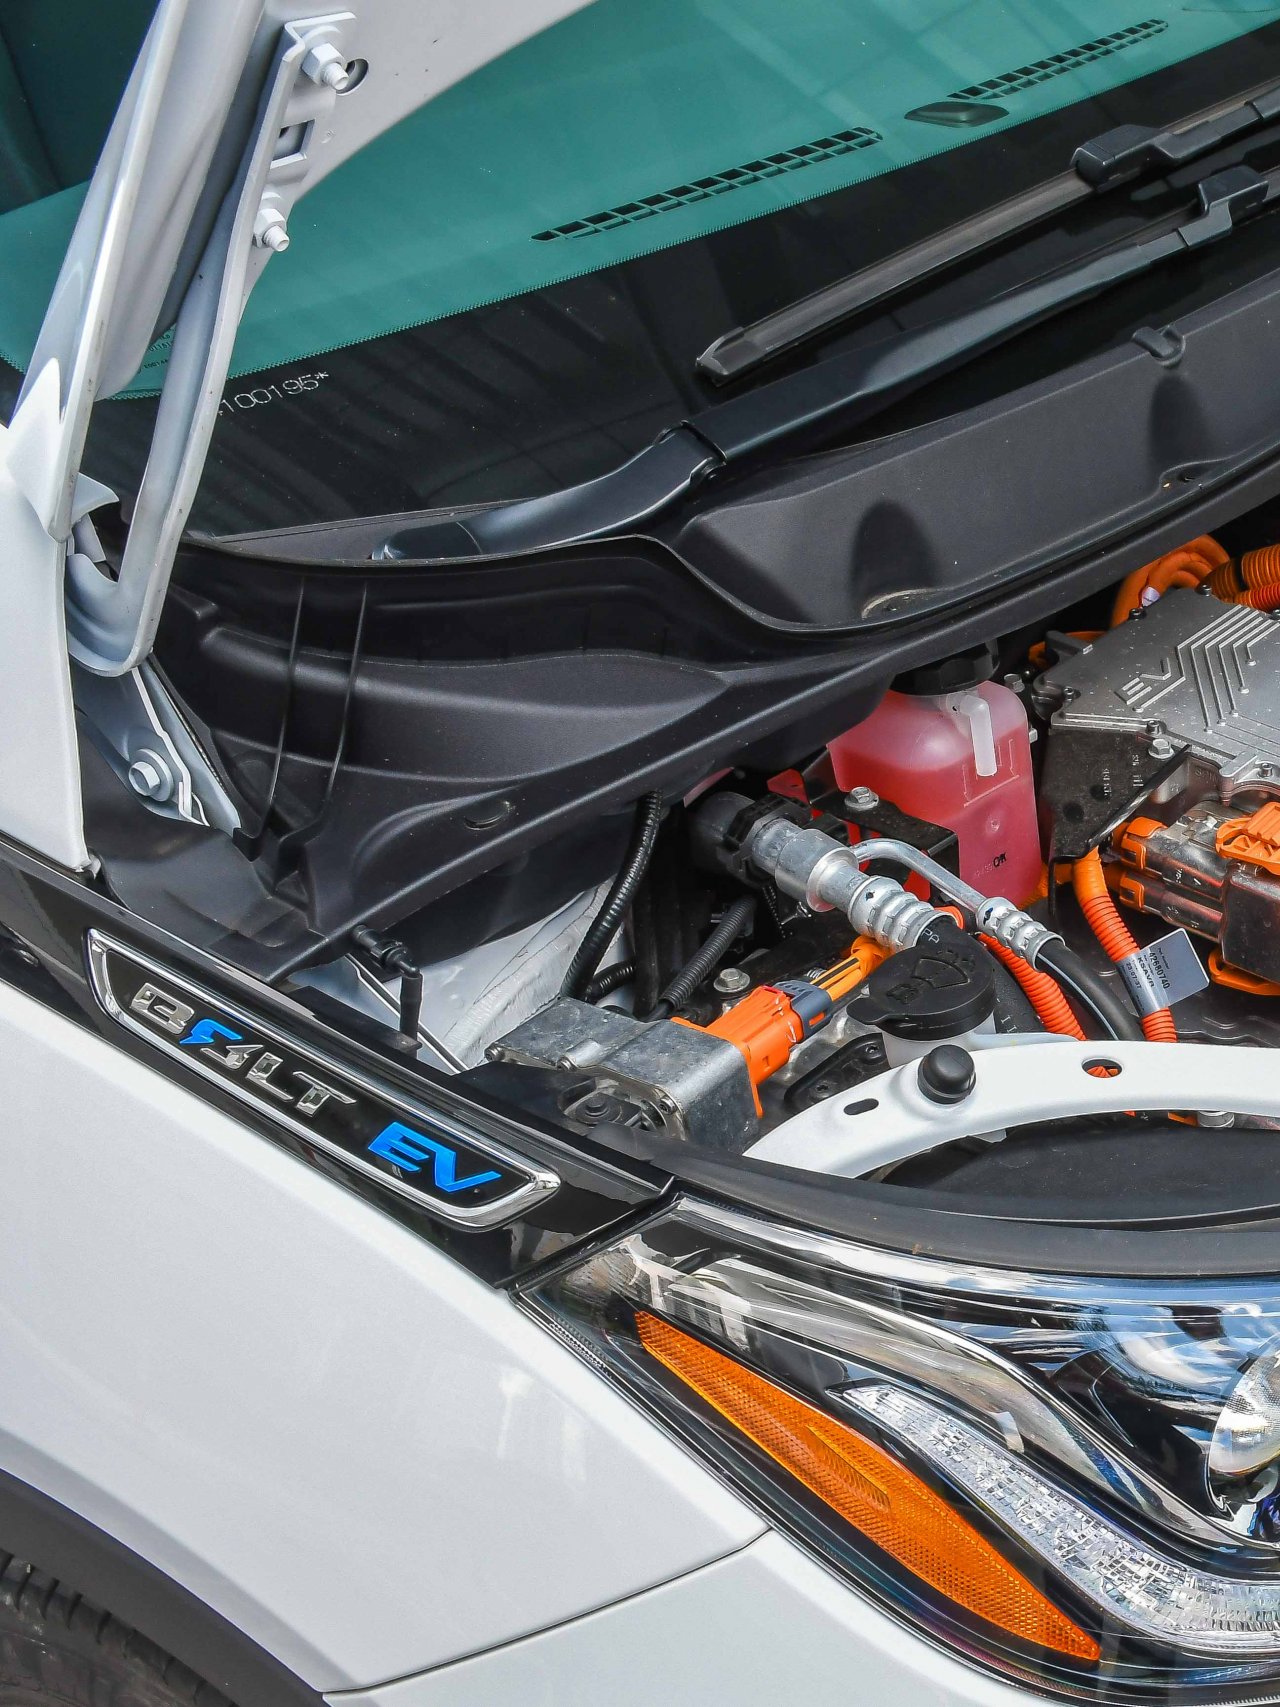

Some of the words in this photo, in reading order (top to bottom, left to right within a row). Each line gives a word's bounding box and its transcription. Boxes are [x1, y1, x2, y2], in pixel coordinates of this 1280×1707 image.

[218, 371, 330, 416] 100195
[129, 982, 357, 1118] BOLT
[367, 1121, 502, 1192] EV
